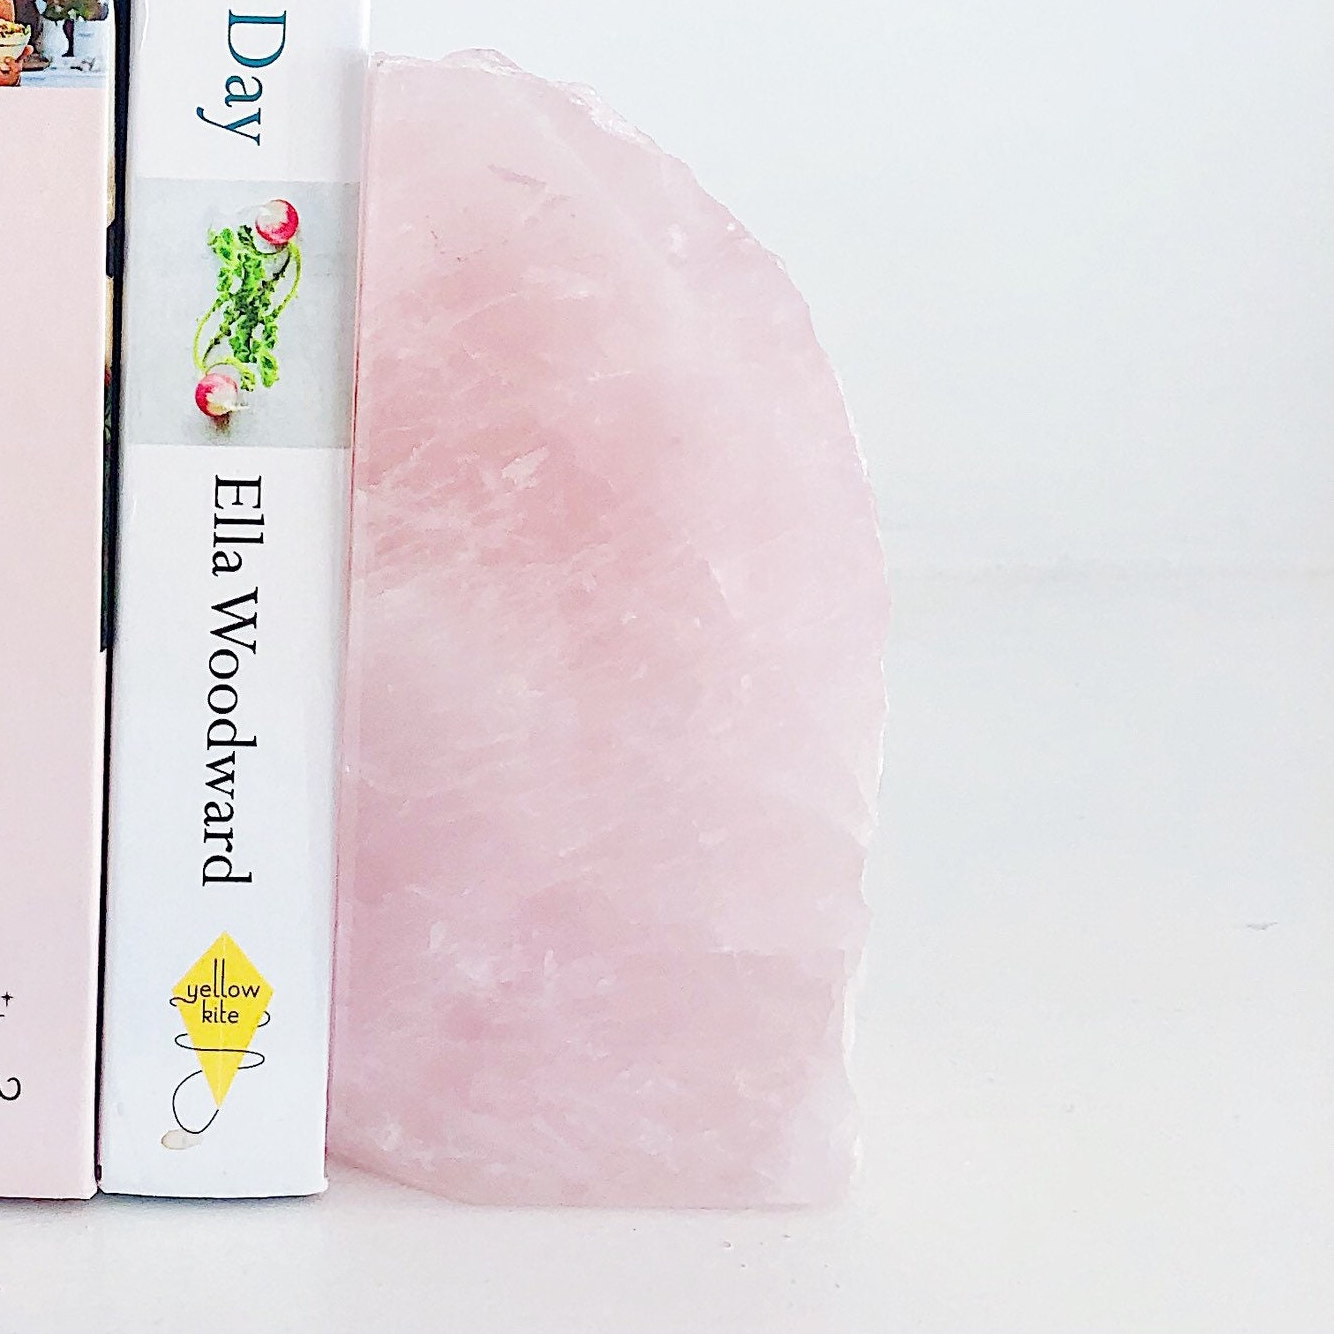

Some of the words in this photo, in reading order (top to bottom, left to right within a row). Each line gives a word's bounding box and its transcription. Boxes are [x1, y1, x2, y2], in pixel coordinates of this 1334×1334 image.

[195, 8, 287, 147] Day
[211, 474, 266, 578] Ella
[201, 585, 259, 888] Woodward
[169, 958, 260, 1008] yellow
[202, 999, 239, 1024] kite
